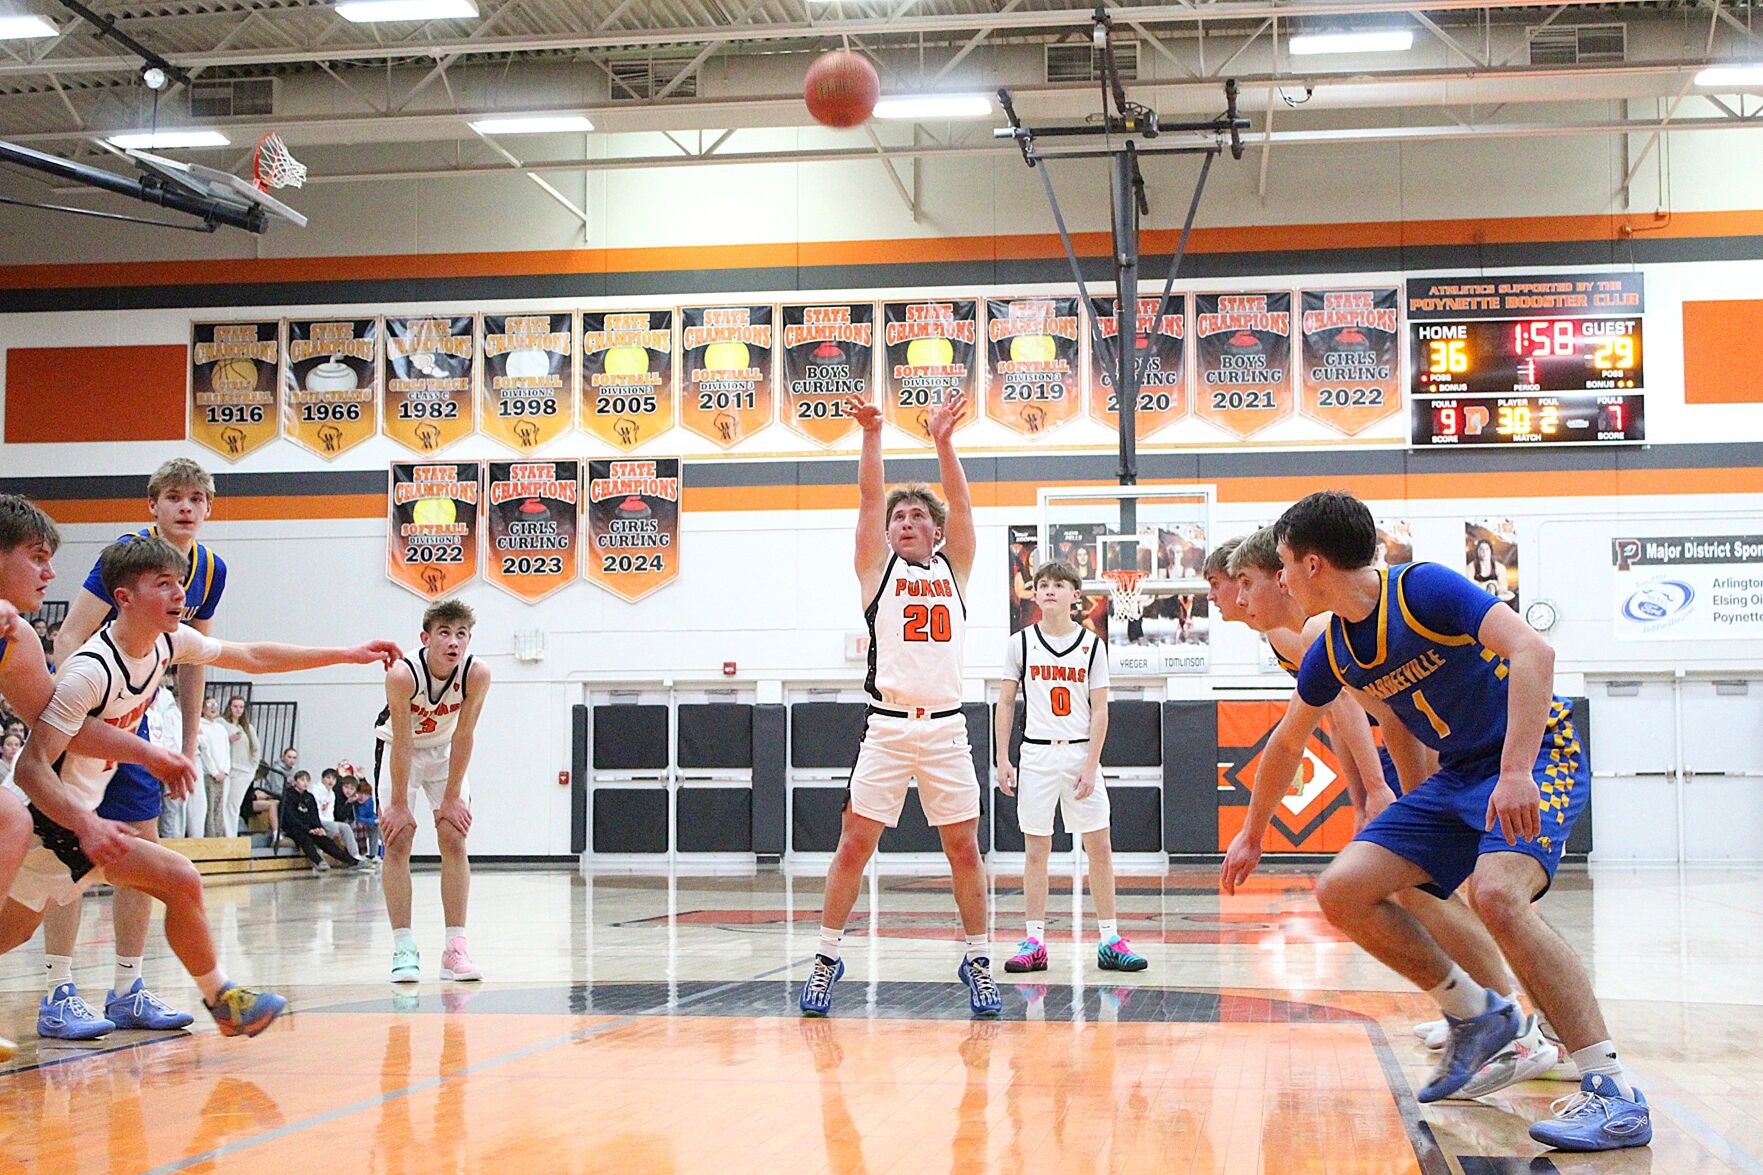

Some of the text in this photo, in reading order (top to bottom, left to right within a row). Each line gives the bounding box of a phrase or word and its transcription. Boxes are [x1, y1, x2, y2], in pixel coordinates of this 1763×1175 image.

[1429, 281, 1622, 295] ATHLETICS SUPPORTED BY THE
[1218, 295, 1266, 313] STATE
[1324, 292, 1373, 309] STATE
[1410, 293, 1639, 311] POYNETTE BOOSTER CLUB
[704, 309, 750, 325] STATE
[804, 307, 850, 324] STATE
[906, 304, 953, 321] STATE
[1303, 307, 1396, 334] CHAMPIONS
[505, 316, 550, 333] STATE
[604, 314, 650, 330] STATE
[990, 317, 1077, 342] CHAMPIONS
[1197, 312, 1289, 337] CHAMPIONS
[1582, 321, 1635, 336] GUEST
[685, 325, 771, 350] CHAMPIONS
[785, 323, 871, 348] CHAMPIONS
[887, 321, 974, 345] CHAMPIONS
[1419, 326, 1467, 339] HOME
[1514, 321, 1575, 356] 1:58
[486, 332, 570, 357] CHAMPIONS
[585, 330, 670, 354] CHAMPIONS
[1324, 352, 1376, 366] GIRLS
[1429, 341, 1468, 372] 36
[1594, 336, 1634, 369] 29
[998, 360, 1069, 374] SOFTBALL
[1221, 355, 1267, 369] BOYS
[692, 369, 762, 382] SOFTBALL
[806, 366, 849, 379] BOYS
[895, 364, 967, 379] SOFTBALL
[1007, 374, 1052, 382] DIVISION
[1101, 372, 1176, 387] CING
[1205, 368, 1282, 384] CURLING
[1311, 366, 1389, 381] CURLING
[1602, 370, 1624, 378] POSS
[493, 375, 562, 389] SOFTBALL
[592, 373, 661, 387] SOFTBALL
[701, 382, 743, 390] DIVISION
[792, 380, 864, 394] CURLING
[903, 378, 949, 387] DIVISION
[1586, 380, 1615, 388] BONUS
[408, 392, 440, 400] CLASS
[502, 389, 544, 397] DIVISION
[601, 386, 645, 395] DIVISION
[1004, 383, 1064, 401] 2019
[1318, 388, 1383, 406] 2022
[499, 399, 557, 416] 1998
[597, 397, 657, 414] 2005
[699, 393, 755, 409] 2011
[1106, 394, 1170, 411] 220
[1213, 390, 1276, 410] 2021
[207, 406, 263, 422] 1916
[303, 404, 360, 420] 1966
[399, 401, 457, 418] 1982
[1441, 409, 1456, 434] 9
[1608, 405, 1622, 431] 7
[1598, 432, 1624, 440] SCORE
[413, 466, 457, 481] STATE
[510, 464, 555, 480] STATE
[610, 462, 656, 478] STATE
[395, 481, 476, 505] CHAMPIONS
[491, 480, 576, 505] CHAMPIONS
[591, 478, 677, 503] CHAMPIONS
[401, 523, 467, 536] SOFTBALL
[509, 522, 557, 535] GIRLS
[609, 520, 657, 533] GIRLS
[409, 537, 452, 545] DIVISION
[497, 535, 568, 550] CURLING
[598, 533, 669, 548] CURLING
[405, 546, 464, 563] 2022
[1647, 543, 1681, 562] Major
[1685, 541, 1730, 558] District
[503, 557, 562, 575] 2023
[603, 555, 663, 572] 2024
[896, 578, 952, 597] PUMAS
[1713, 595, 1747, 608] Elsing
[903, 604, 952, 642] 20
[1120, 659, 1148, 668] YAEGER
[1164, 657, 1205, 667] TOMLINSON
[1029, 665, 1087, 683] PUMAS
[1050, 687, 1071, 716] 0
[1412, 689, 1451, 739] 1
